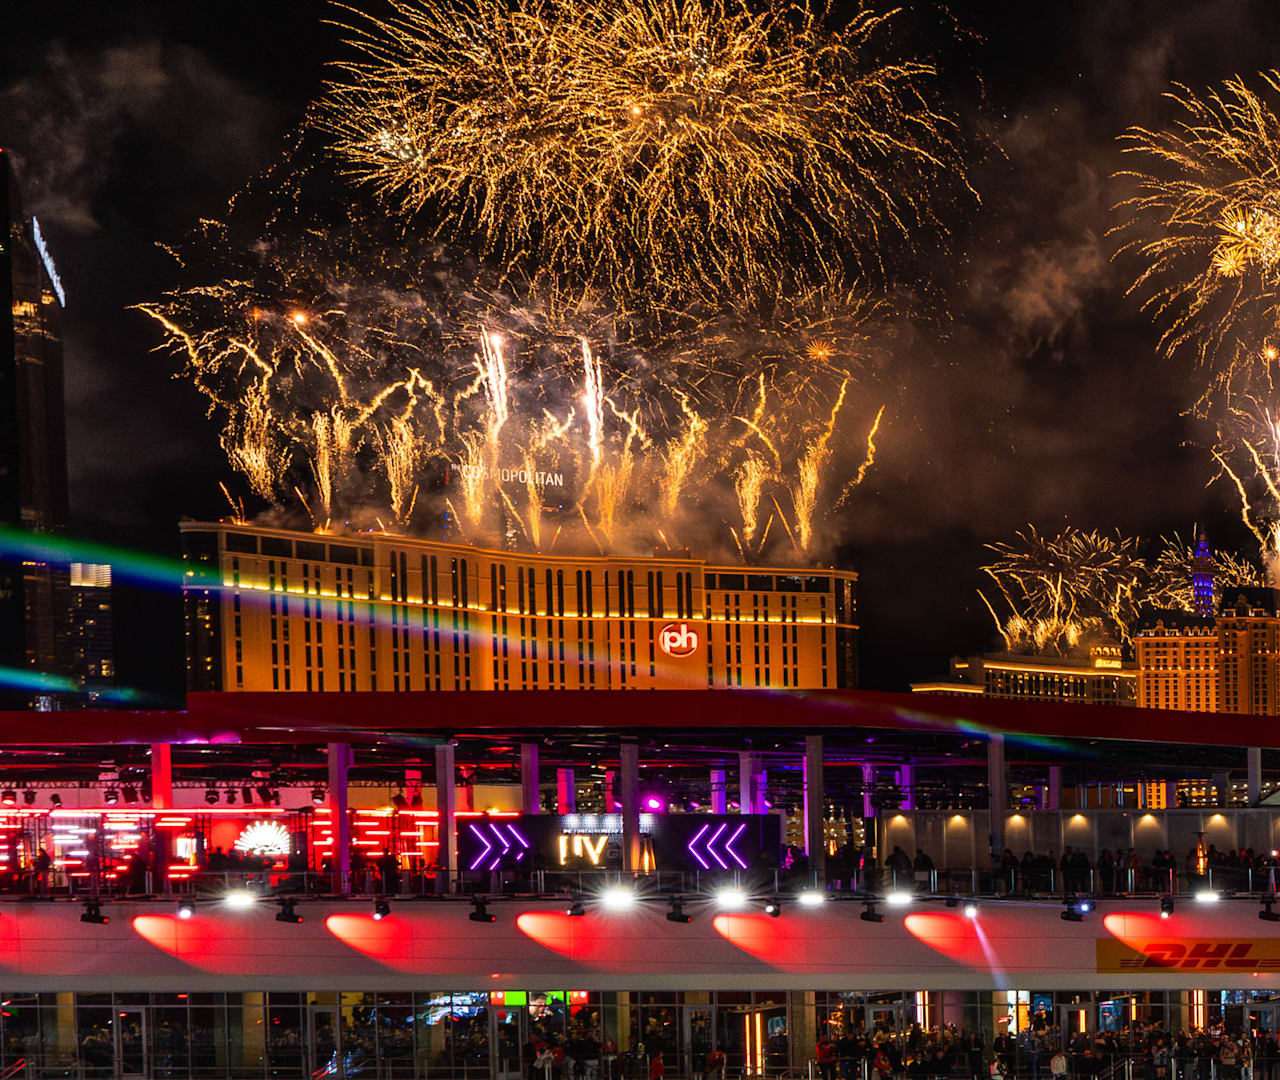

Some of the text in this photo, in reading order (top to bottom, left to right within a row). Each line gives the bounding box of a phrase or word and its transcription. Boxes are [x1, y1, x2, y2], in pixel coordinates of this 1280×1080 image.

[463, 465, 563, 487] COSMOPOLITAN
[664, 624, 698, 657] ph
[1144, 943, 1261, 967] DHL
